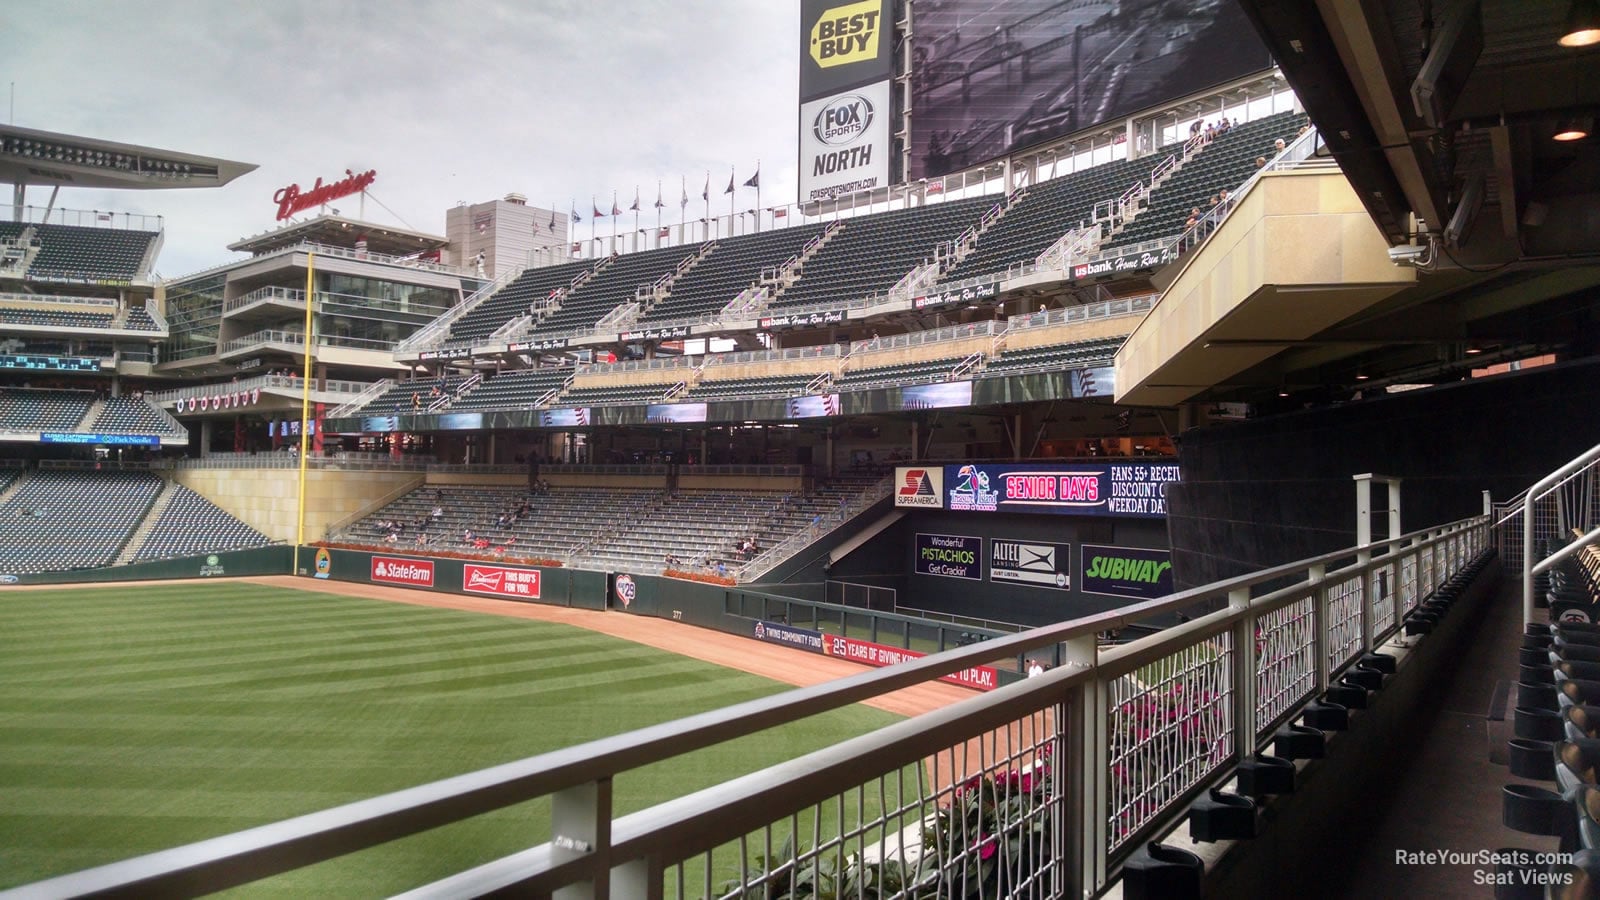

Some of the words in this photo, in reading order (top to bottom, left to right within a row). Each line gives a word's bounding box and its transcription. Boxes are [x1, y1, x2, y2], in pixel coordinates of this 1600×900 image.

[819, 10, 880, 40] BEST
[820, 31, 874, 59] BUY
[825, 101, 861, 130] FOX
[825, 122, 861, 139] SPORTS
[813, 144, 872, 177] NORTH
[810, 177, 877, 200] FOXSPORTSNORTH.COM
[1075, 261, 1113, 277] usbank
[1114, 258, 1139, 271] Home
[1141, 252, 1159, 267] Run
[916, 294, 942, 307] usbank
[943, 292, 960, 304] Home
[961, 289, 976, 301] Run
[977, 283, 995, 297] Porch
[761, 317, 789, 328] usbank
[791, 315, 809, 325] Home
[810, 314, 823, 324] Run
[824, 311, 843, 322] Porch
[1111, 466, 1132, 481] FANS
[1134, 466, 1148, 481] 55+
[1006, 476, 1057, 499] SENIOR
[1060, 477, 1099, 501] DAYS
[1112, 482, 1157, 497] DISCOUNT
[898, 495, 937, 505] SUPERAMERICA
[1108, 498, 1149, 513] WEEKDAY
[931, 537, 963, 548] Wonderful
[921, 547, 974, 564] PISTACHIOS
[993, 542, 1019, 561] ALTEC
[928, 563, 941, 574] Get
[941, 564, 967, 577] Crackin'
[992, 560, 1019, 568] LANSING
[1086, 556, 1172, 583] SUBWAY
[505, 572, 518, 582] THIS
[519, 573, 536, 583] BUD'S
[505, 582, 516, 592] FOR
[517, 584, 530, 593] YOU.
[625, 583, 635, 597] 29
[673, 610, 682, 619] 377
[766, 627, 780, 639] TWINS
[781, 630, 808, 644] COMMUNITY
[809, 636, 821, 647] FUND
[833, 638, 846, 656] 25
[847, 643, 867, 659] YEARS
[869, 647, 878, 660] OF
[879, 649, 901, 664] GIVING
[971, 669, 992, 687] PLAY.
